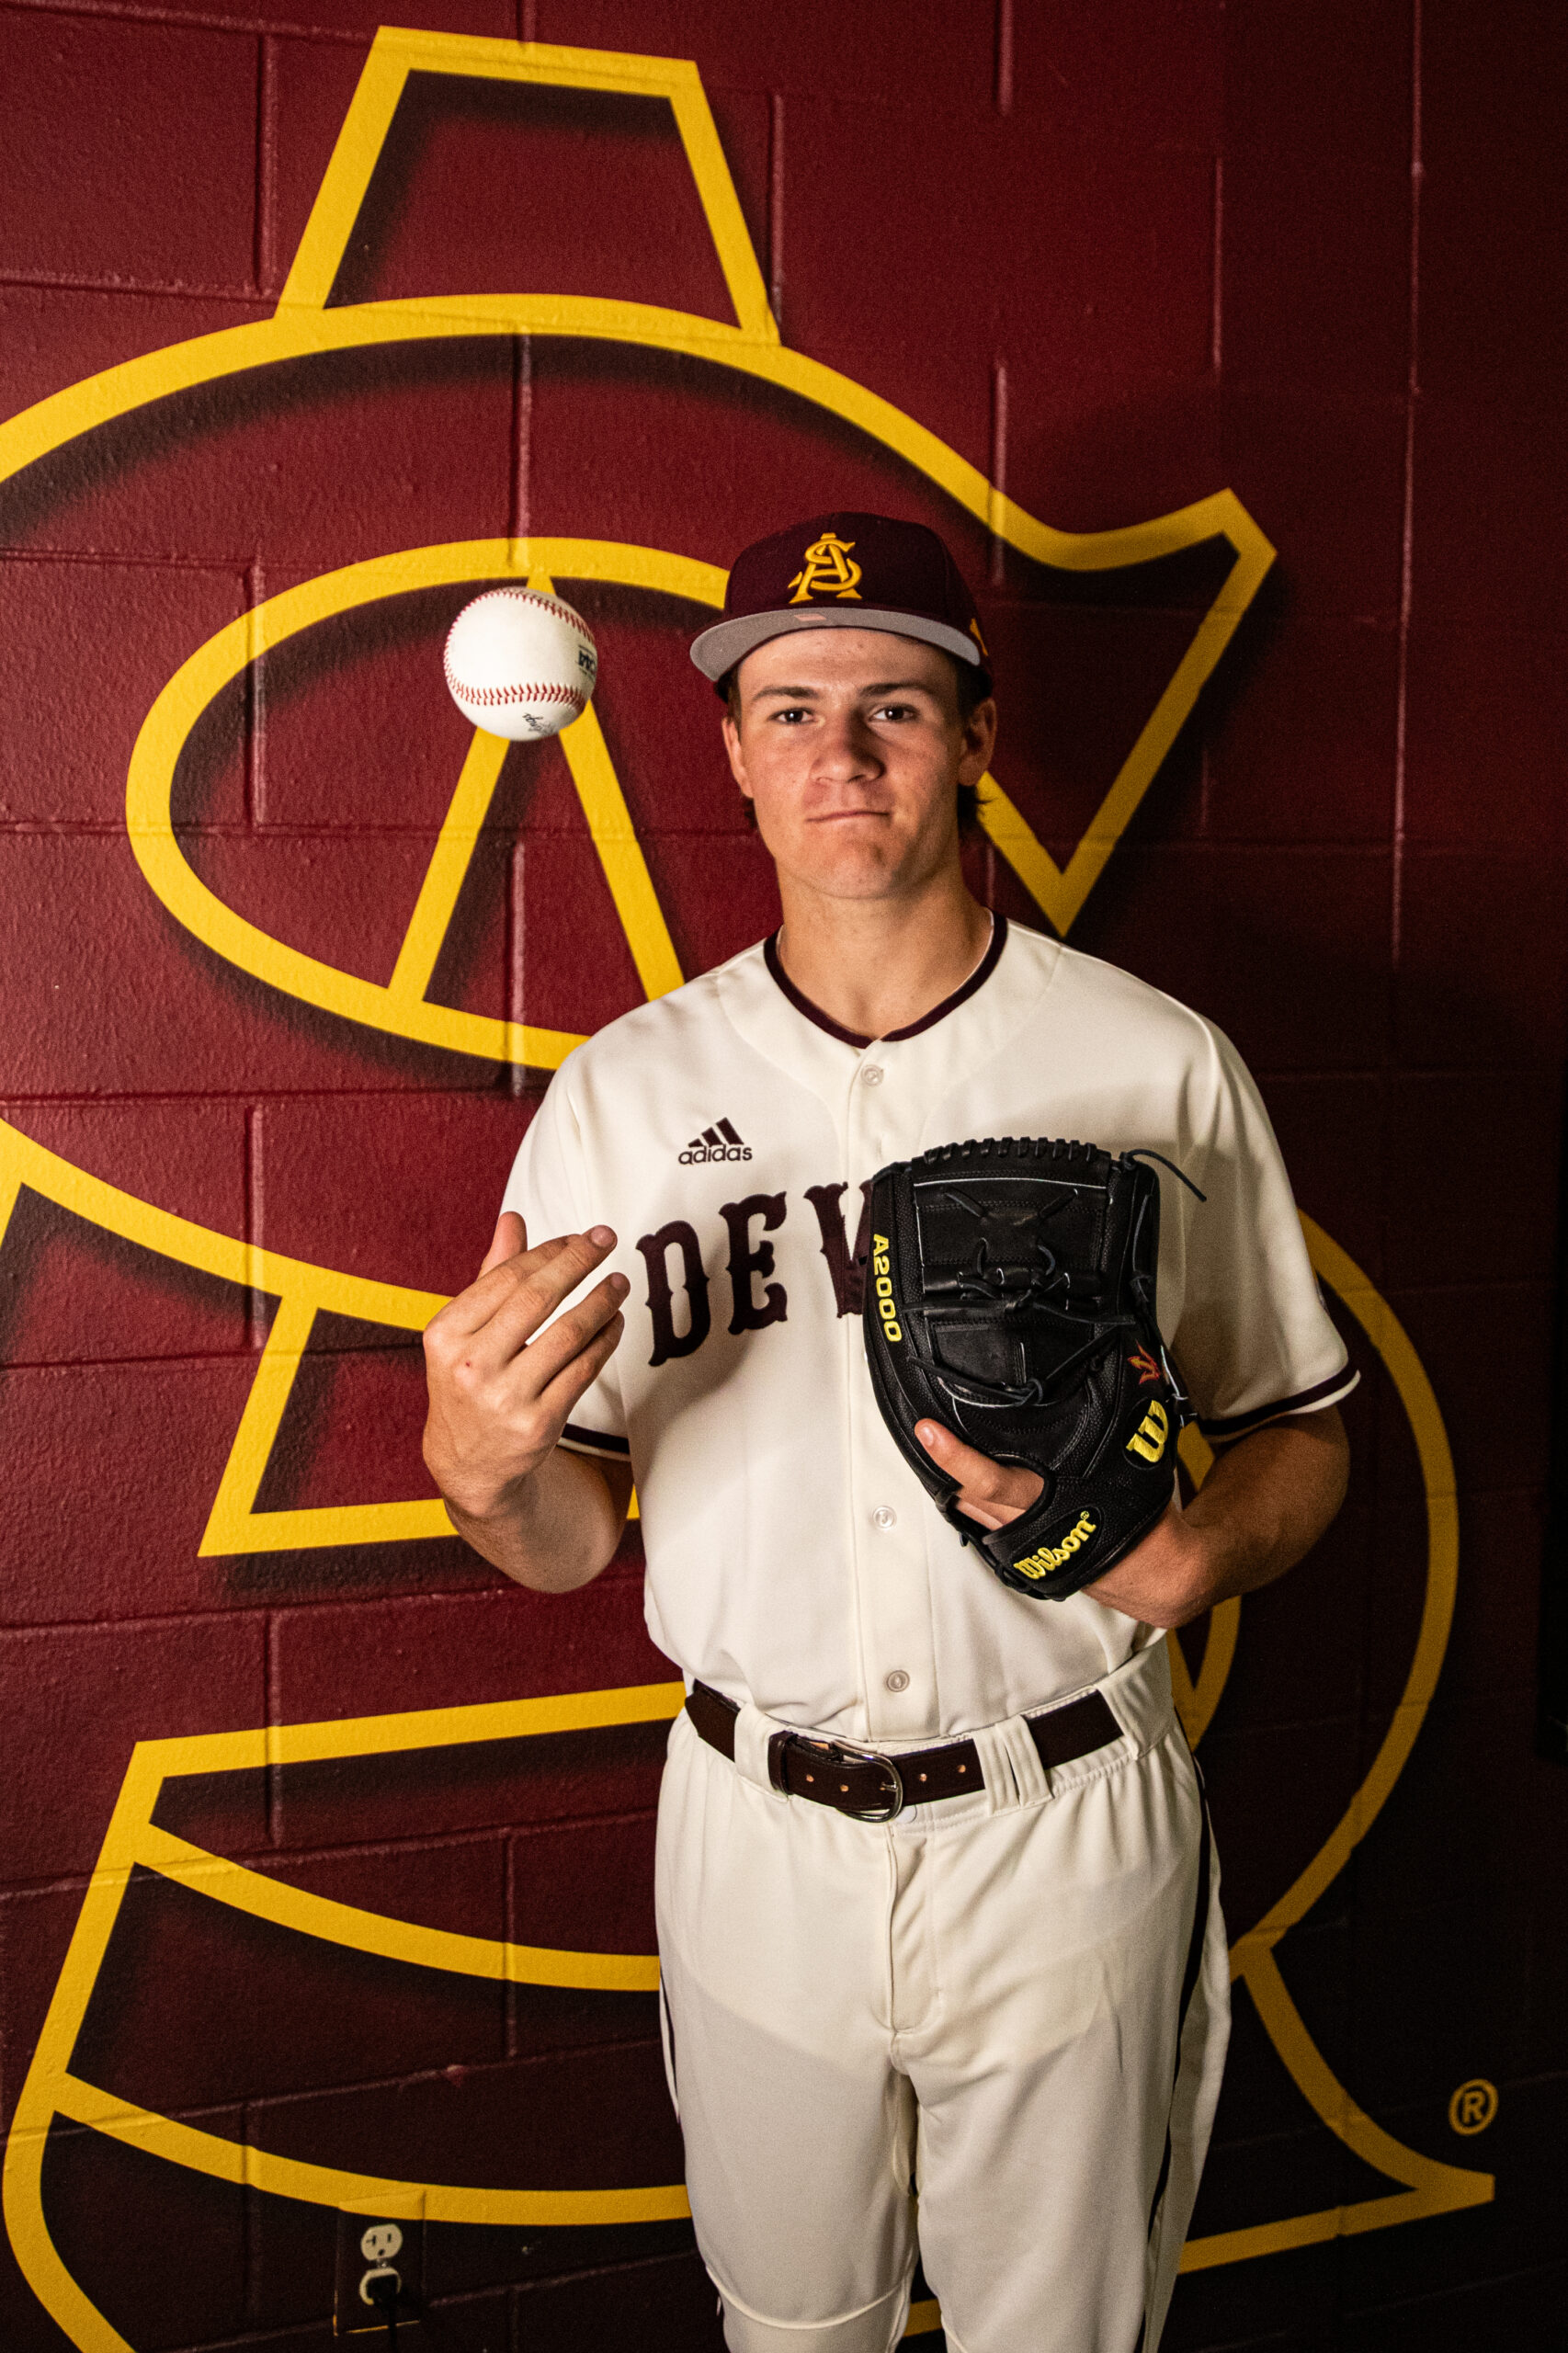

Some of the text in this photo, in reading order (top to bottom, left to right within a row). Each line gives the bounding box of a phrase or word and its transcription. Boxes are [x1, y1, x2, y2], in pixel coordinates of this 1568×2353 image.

[678, 1144, 753, 1165] adidas
[872, 1233, 903, 1343] A2000
[1126, 1400, 1169, 1463] W
